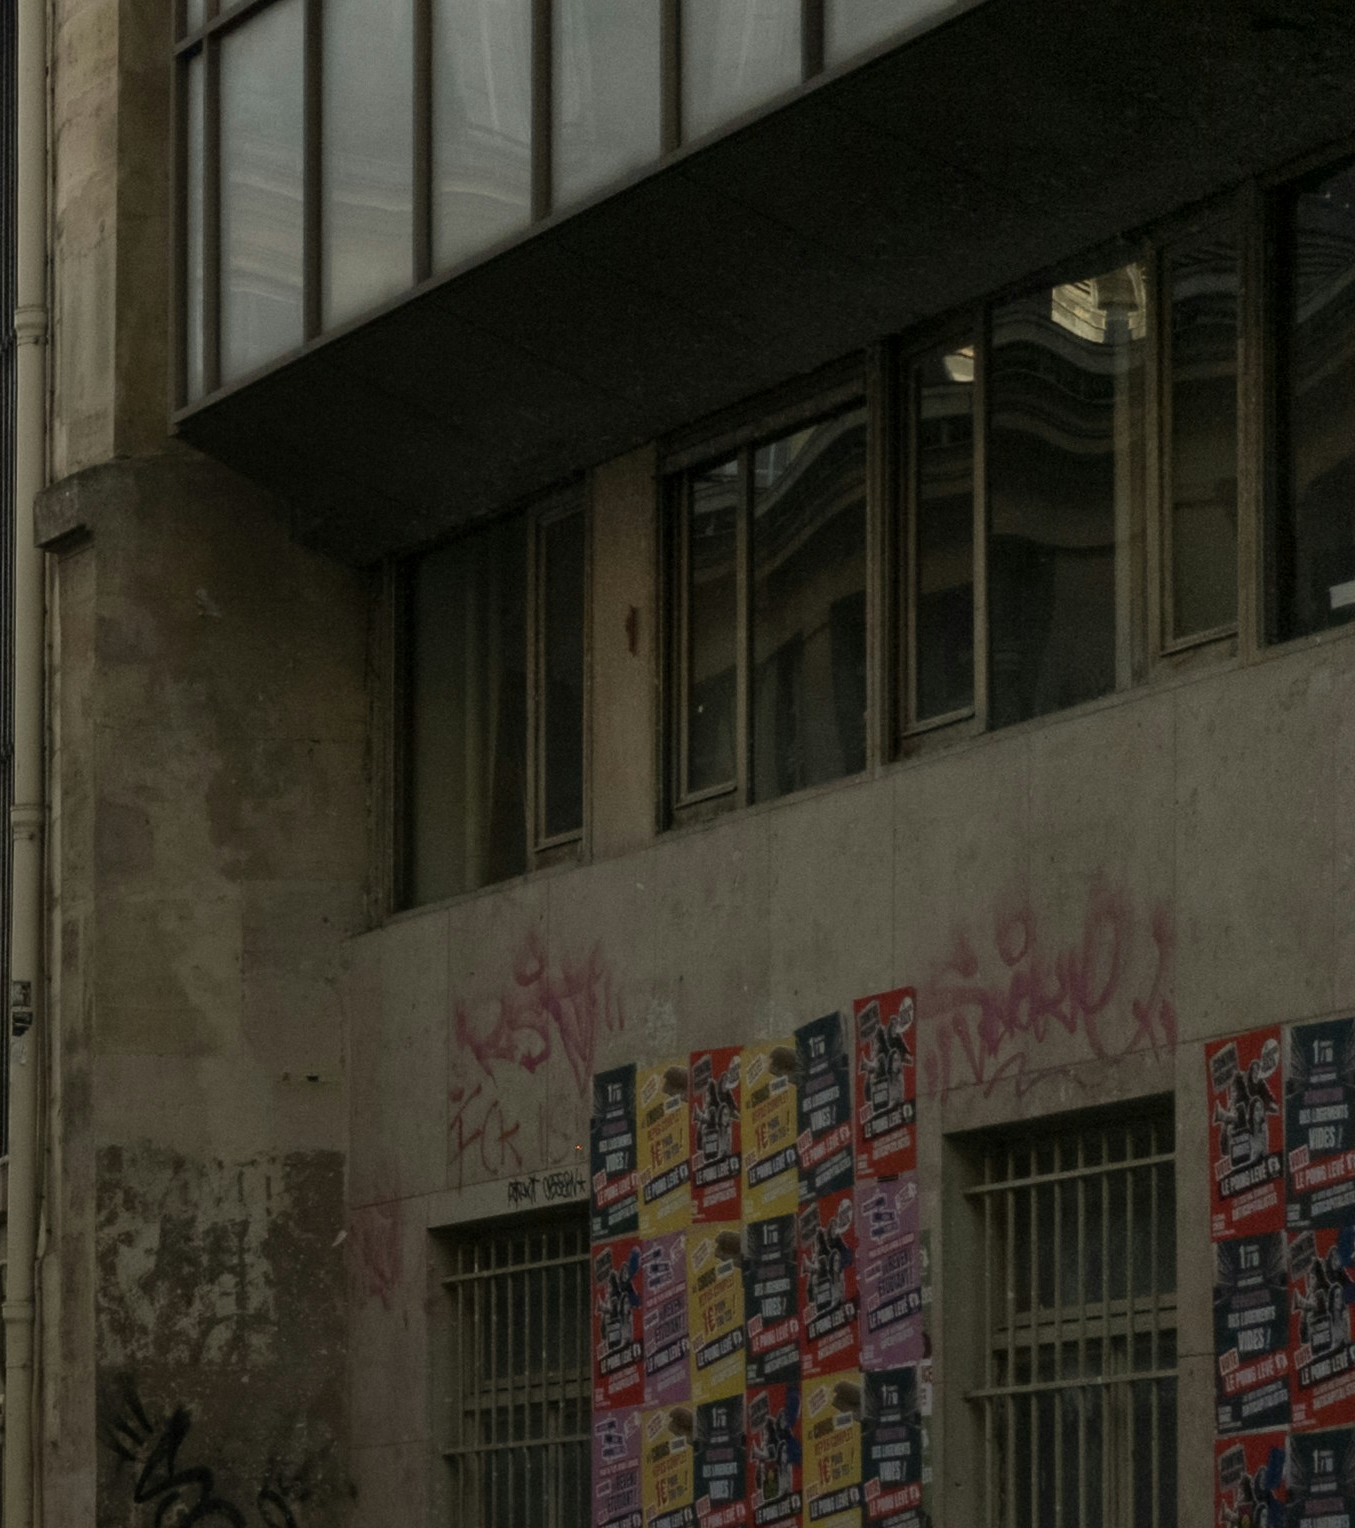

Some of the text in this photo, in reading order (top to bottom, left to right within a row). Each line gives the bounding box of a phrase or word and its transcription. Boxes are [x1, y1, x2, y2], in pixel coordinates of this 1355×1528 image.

[1308, 1125, 1335, 1150] VIDES
[1221, 1177, 1229, 1197] LE
[1295, 1170, 1304, 1189] LE
[1237, 1326, 1264, 1352] VIDES
[1225, 1373, 1235, 1392] LE
[1301, 1366, 1310, 1386] LE
